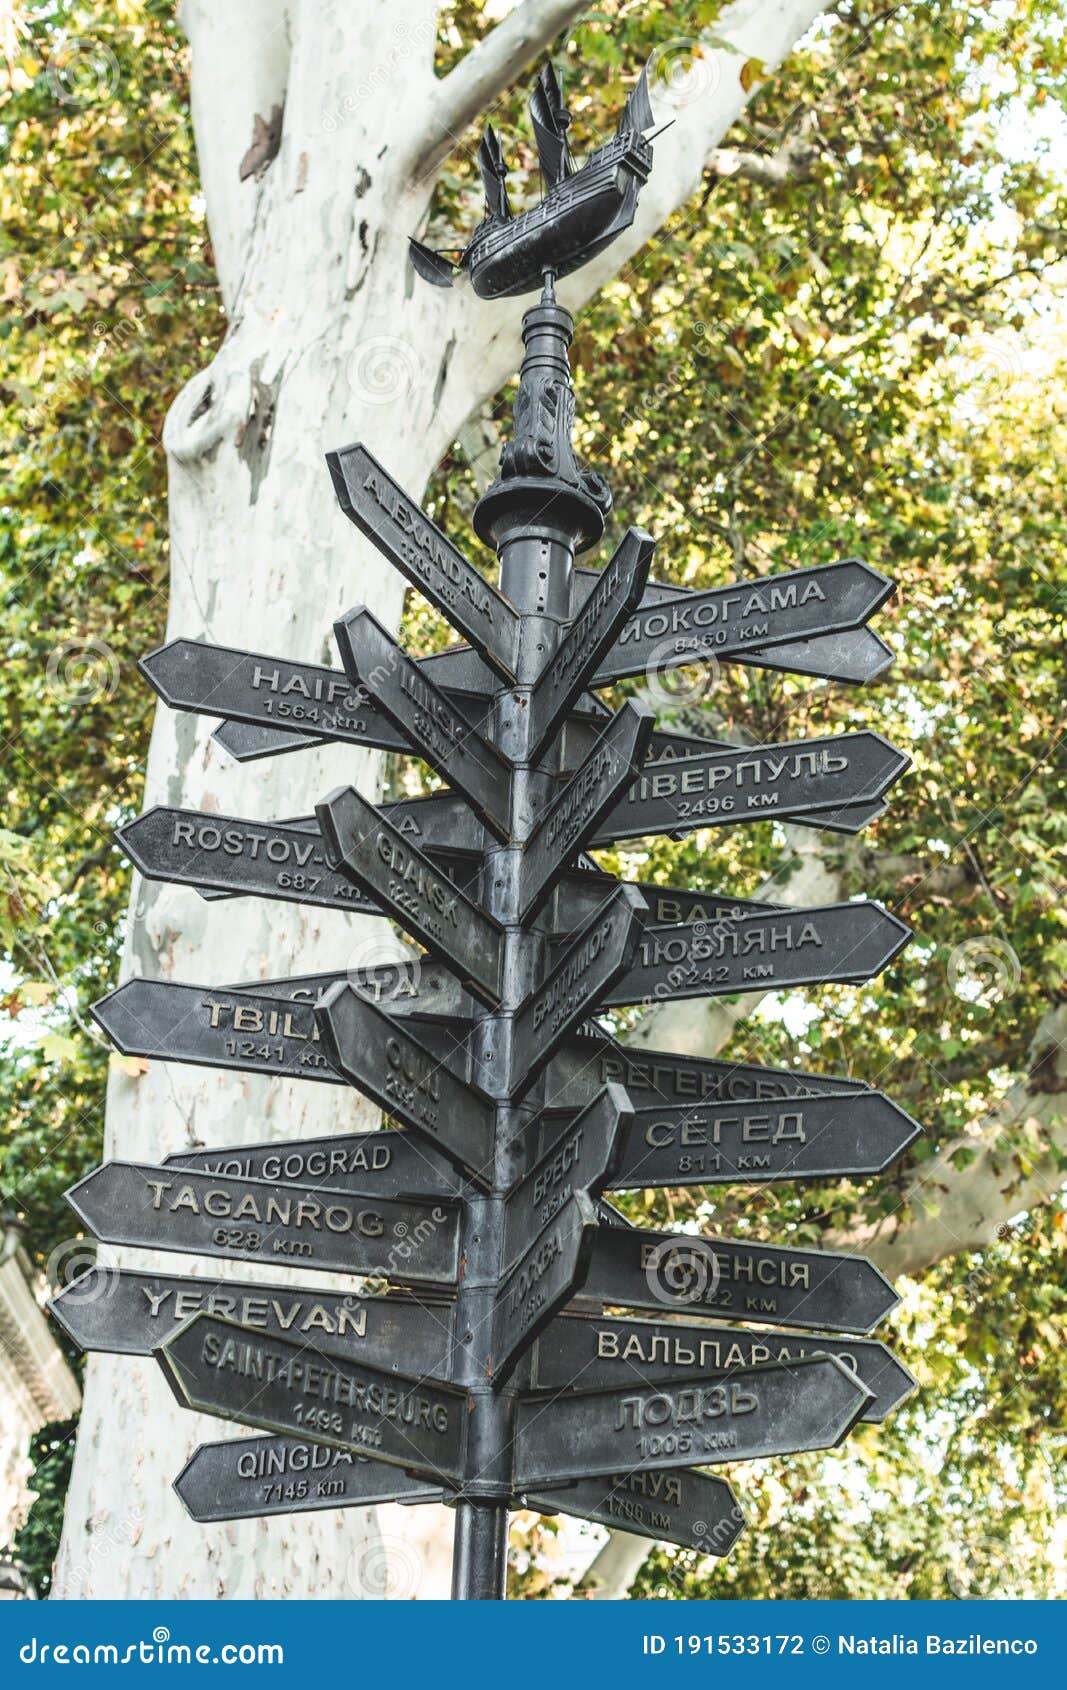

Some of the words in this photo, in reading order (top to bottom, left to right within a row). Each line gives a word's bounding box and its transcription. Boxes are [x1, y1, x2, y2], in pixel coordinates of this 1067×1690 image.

[363, 472, 494, 624] ALEXANDRIA
[620, 581, 826, 643] ЙОКОГАМА
[675, 630, 727, 652] 8460
[264, 700, 320, 722] 1564
[331, 713, 367, 732] km
[677, 796, 735, 818] 2496
[277, 871, 321, 892] 687
[376, 832, 458, 928] GDANSK
[225, 1039, 285, 1063] 1241
[600, 1058, 838, 1100] РЕГЕНСБУ
[645, 1113, 806, 1148] СЕГЕД
[533, 1129, 583, 1207] БРЕСТ
[678, 1154, 722, 1173] 811
[148, 1180, 385, 1237] TAGANROG
[213, 1228, 262, 1251] 628
[273, 1238, 313, 1257] km
[640, 1244, 809, 1289] ВАЛЕНСІЯ
[141, 1287, 367, 1337] YEREVAN
[598, 1332, 858, 1368] ВАЛЬПАРАО
[202, 1332, 448, 1433] SAINT-PETERSBURG
[294, 1403, 343, 1434] 1493
[614, 1383, 759, 1431] ЛОДЗЬ
[237, 1445, 369, 1478] QINGDA
[636, 1433, 692, 1459] 1005
[263, 1481, 308, 1503] 7145
[317, 1479, 345, 1496] km
[612, 1471, 681, 1506] ЕНУЯ
